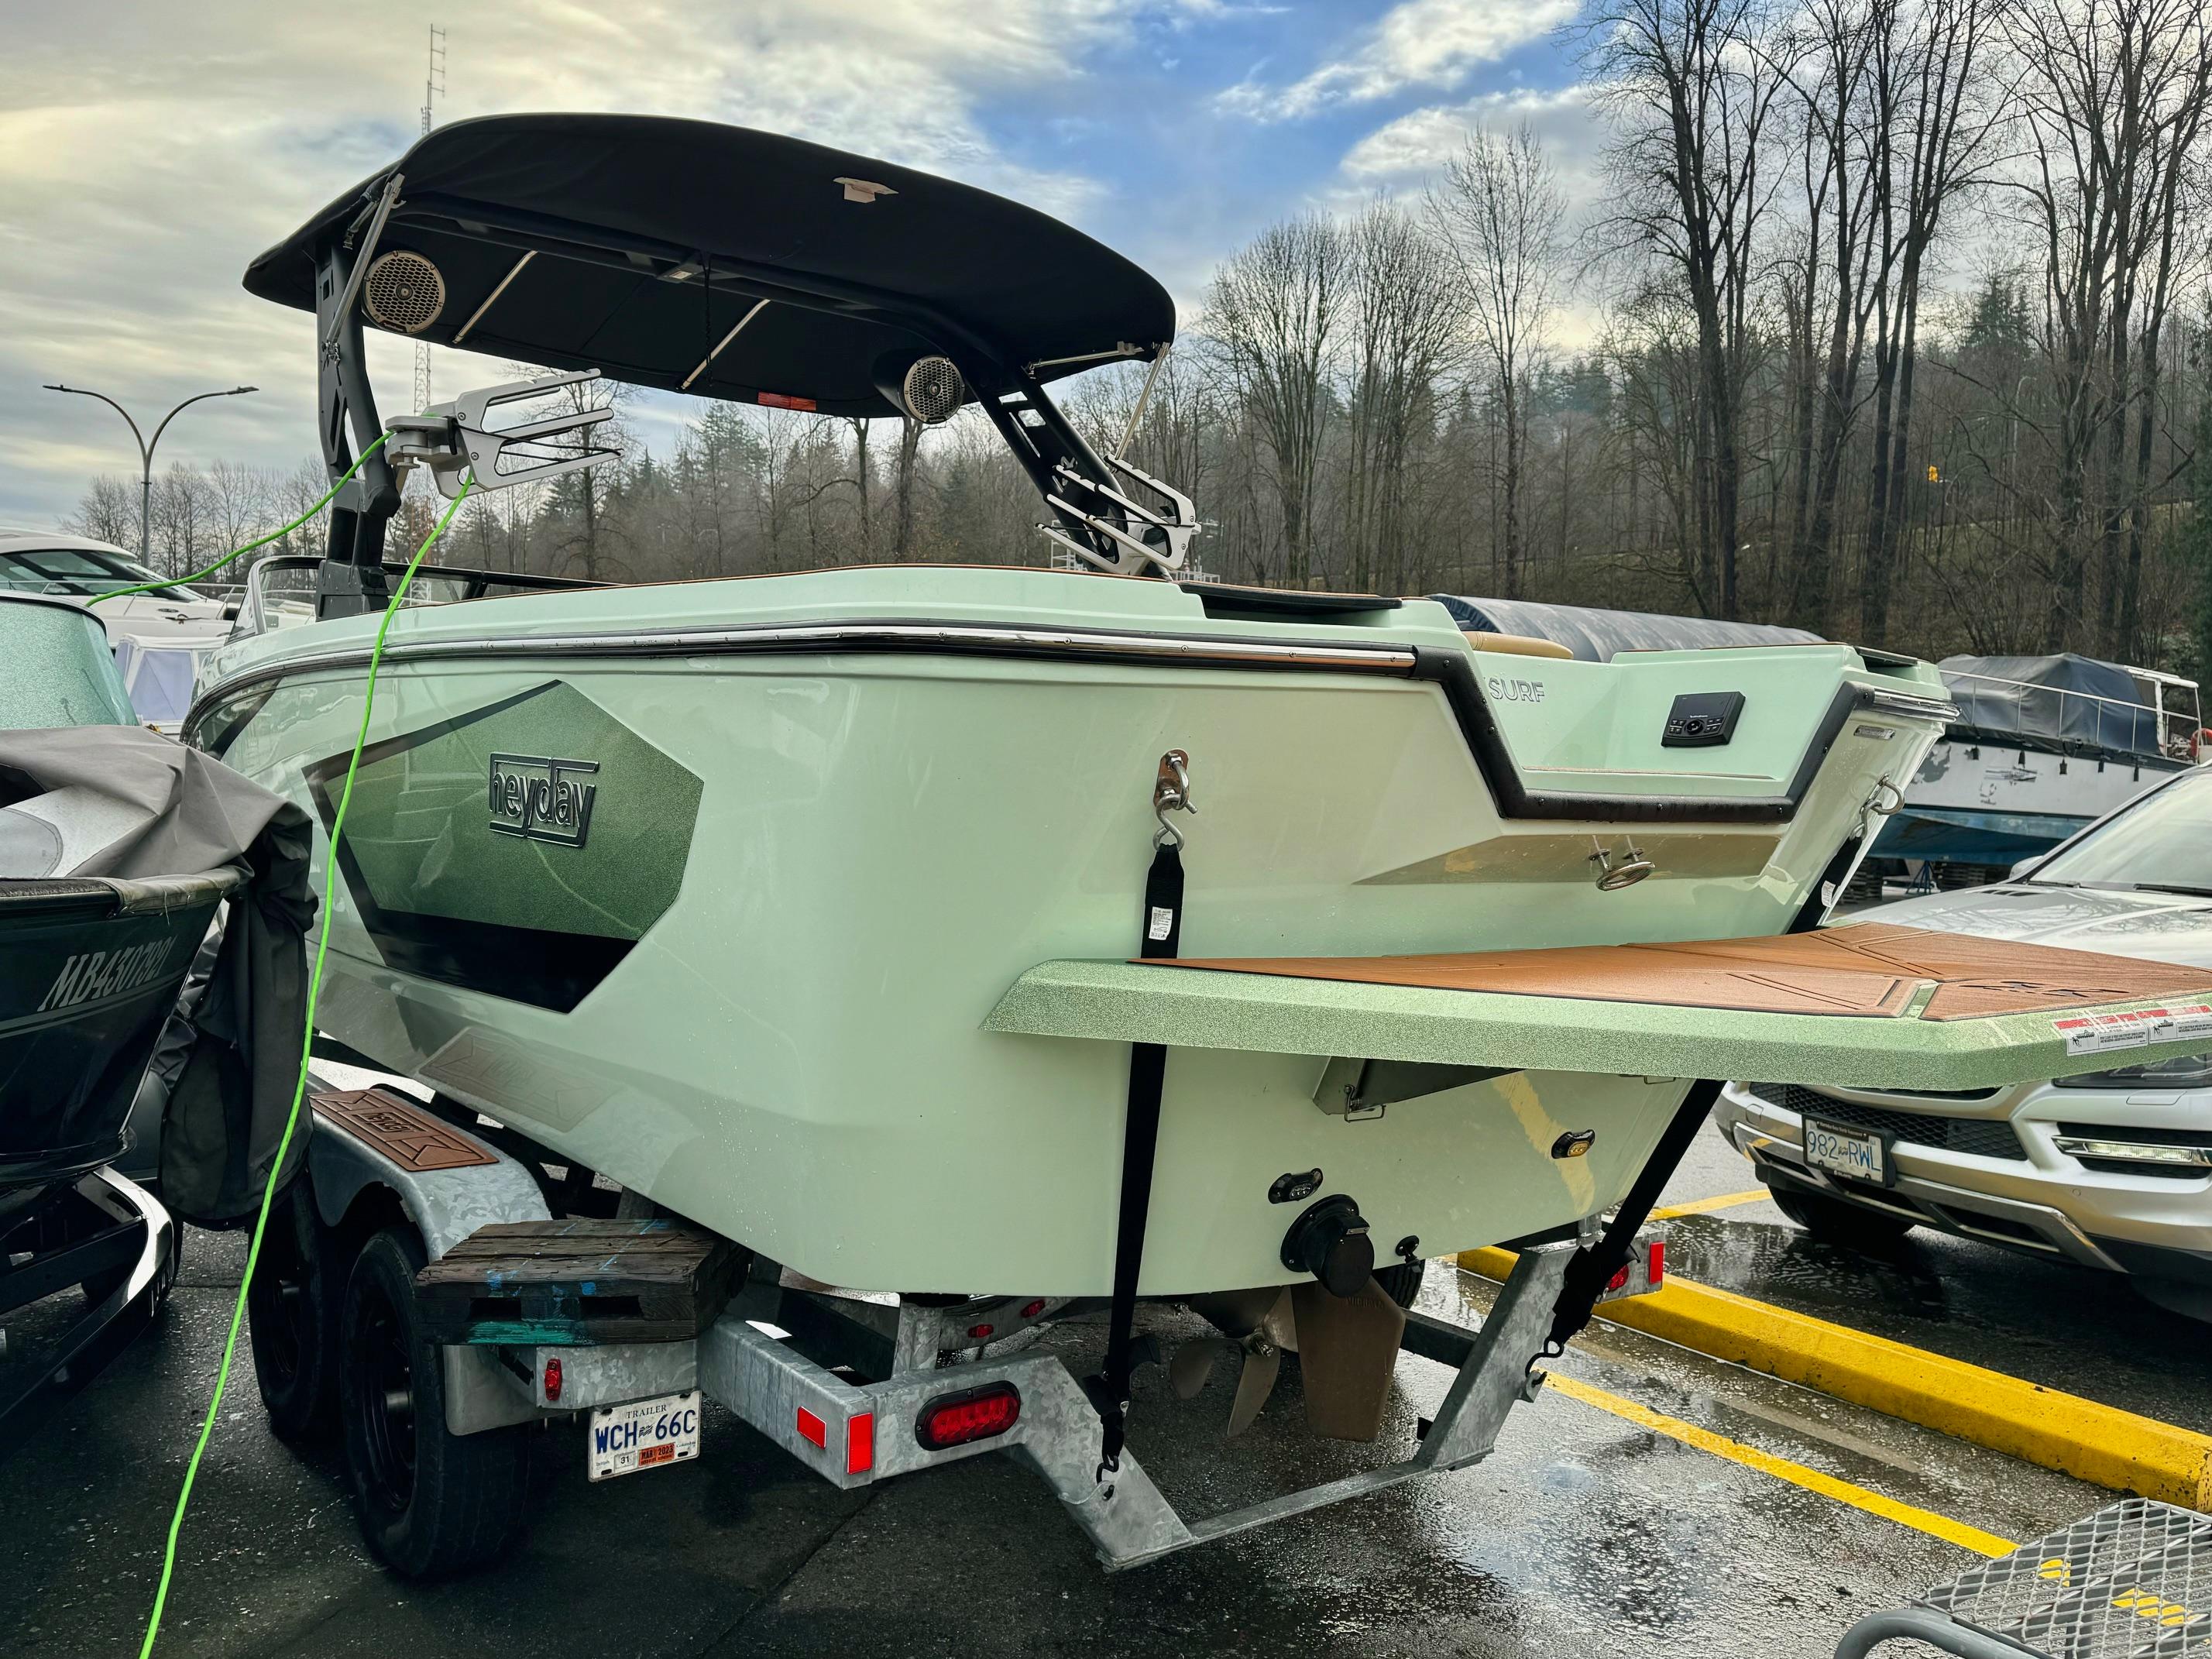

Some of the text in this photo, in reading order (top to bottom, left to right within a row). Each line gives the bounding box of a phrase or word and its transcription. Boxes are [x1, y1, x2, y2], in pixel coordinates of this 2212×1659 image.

[1489, 677, 1545, 702] SURF
[489, 750, 599, 848] heyday
[36, 934, 179, 1012] MB4307921
[1807, 1131, 1882, 1172] 982 RWL
[626, 1404, 667, 1419] TRAILER
[595, 1409, 696, 1455] WCH 66C
[620, 1456, 630, 1465] 31
[641, 1449, 654, 1460] MAR
[658, 1444, 674, 1456] 2023
